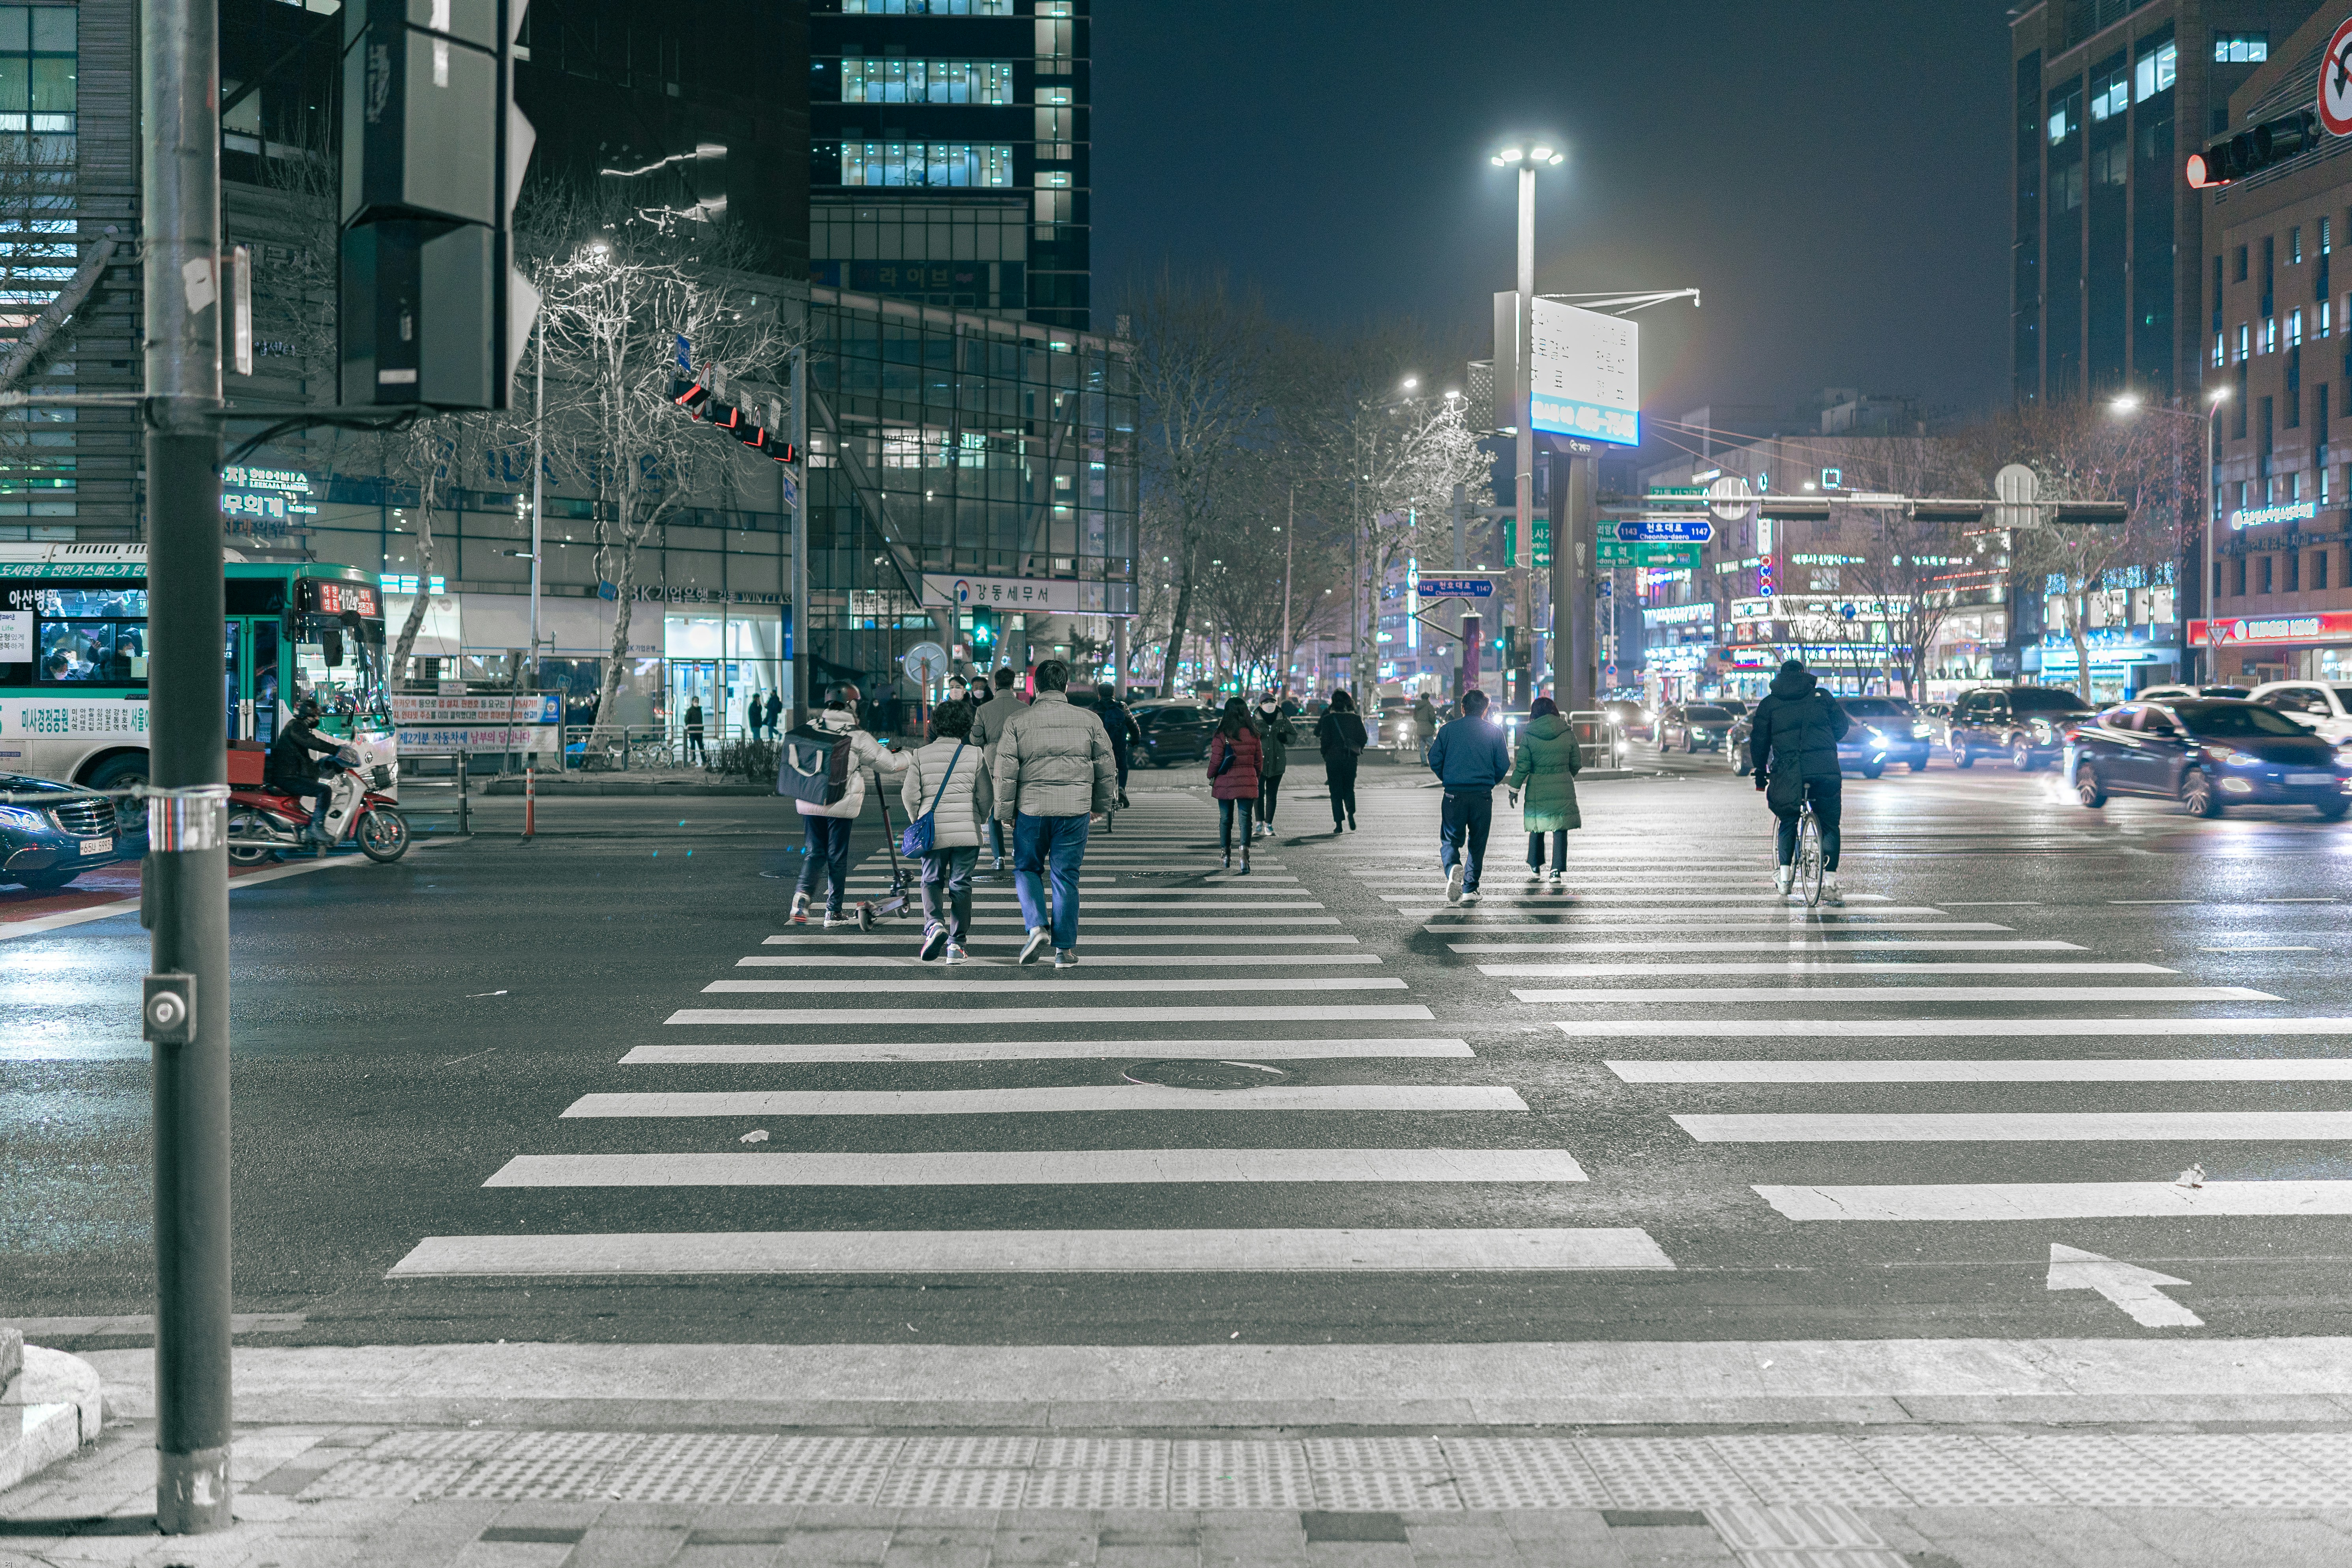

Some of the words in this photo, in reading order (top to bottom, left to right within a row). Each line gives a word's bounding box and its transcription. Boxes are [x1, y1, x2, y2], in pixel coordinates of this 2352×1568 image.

[220, 466, 247, 487] 자
[249, 468, 308, 482] 헤어비스
[221, 494, 284, 518] 무회계
[1621, 527, 1637, 536] 1143
[1646, 523, 1683, 533] 천호대로
[1691, 527, 1708, 536] 1147
[1618, 546, 1627, 557] 역
[1439, 581, 1471, 590] 천호대로
[9, 589, 58, 611] 아산병원
[630, 585, 652, 602] BK
[655, 586, 709, 604] 기업은행
[742, 592, 763, 603] WIN
[975, 584, 1048, 603] 강동세무서
[2248, 620, 2289, 638] BURGER
[2290, 618, 2318, 636] KING
[635, 644, 656, 653] 기업은행
[419, 699, 436, 708] 등으로
[489, 699, 506, 708] 요구는
[22, 708, 69, 732] 미사경정공원
[437, 711, 448, 719] 이미
[399, 732, 429, 745] 제2기분
[433, 731, 468, 745] 자동차세
[470, 731, 496, 745] 납부의
[98, 839, 110, 852] 5993
